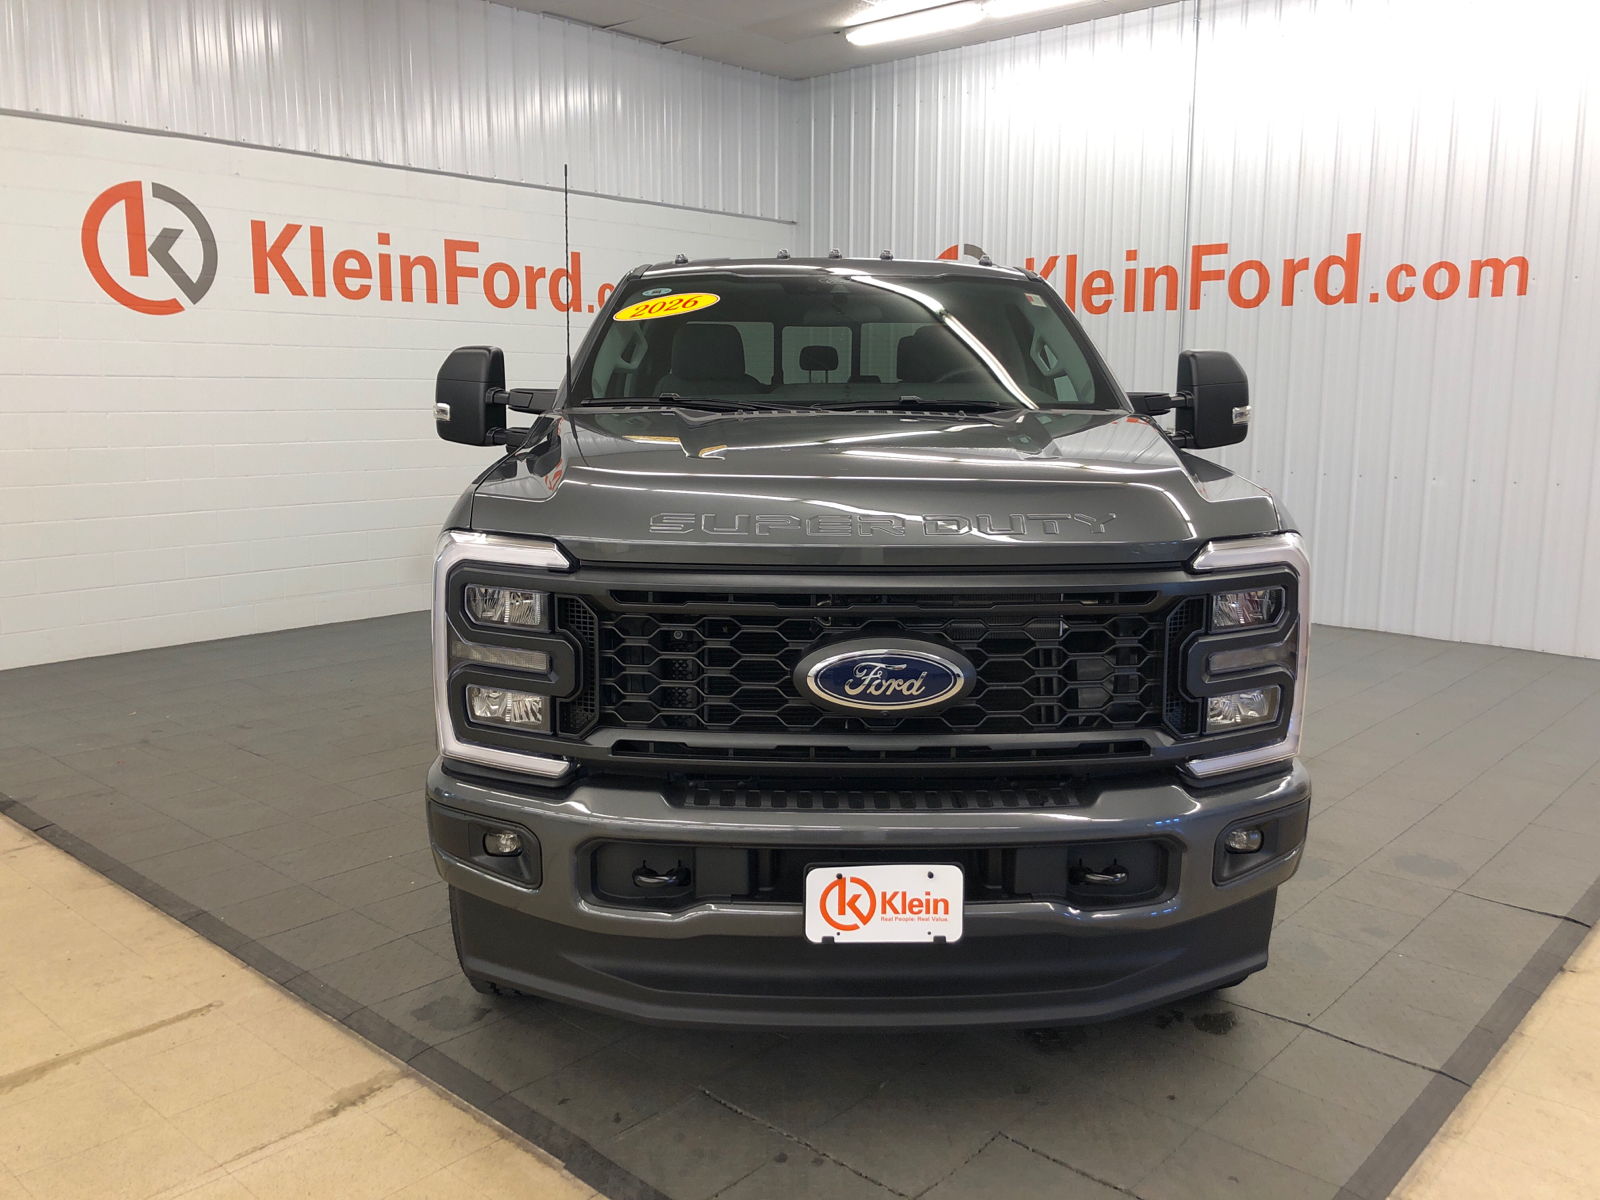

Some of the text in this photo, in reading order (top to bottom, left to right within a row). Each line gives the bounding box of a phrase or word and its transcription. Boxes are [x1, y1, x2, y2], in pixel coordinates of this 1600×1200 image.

[629, 295, 703, 318] 2026
[649, 512, 1117, 537] SUPER DUTY
[844, 662, 927, 697] Ford
[880, 891, 950, 915] Klein
